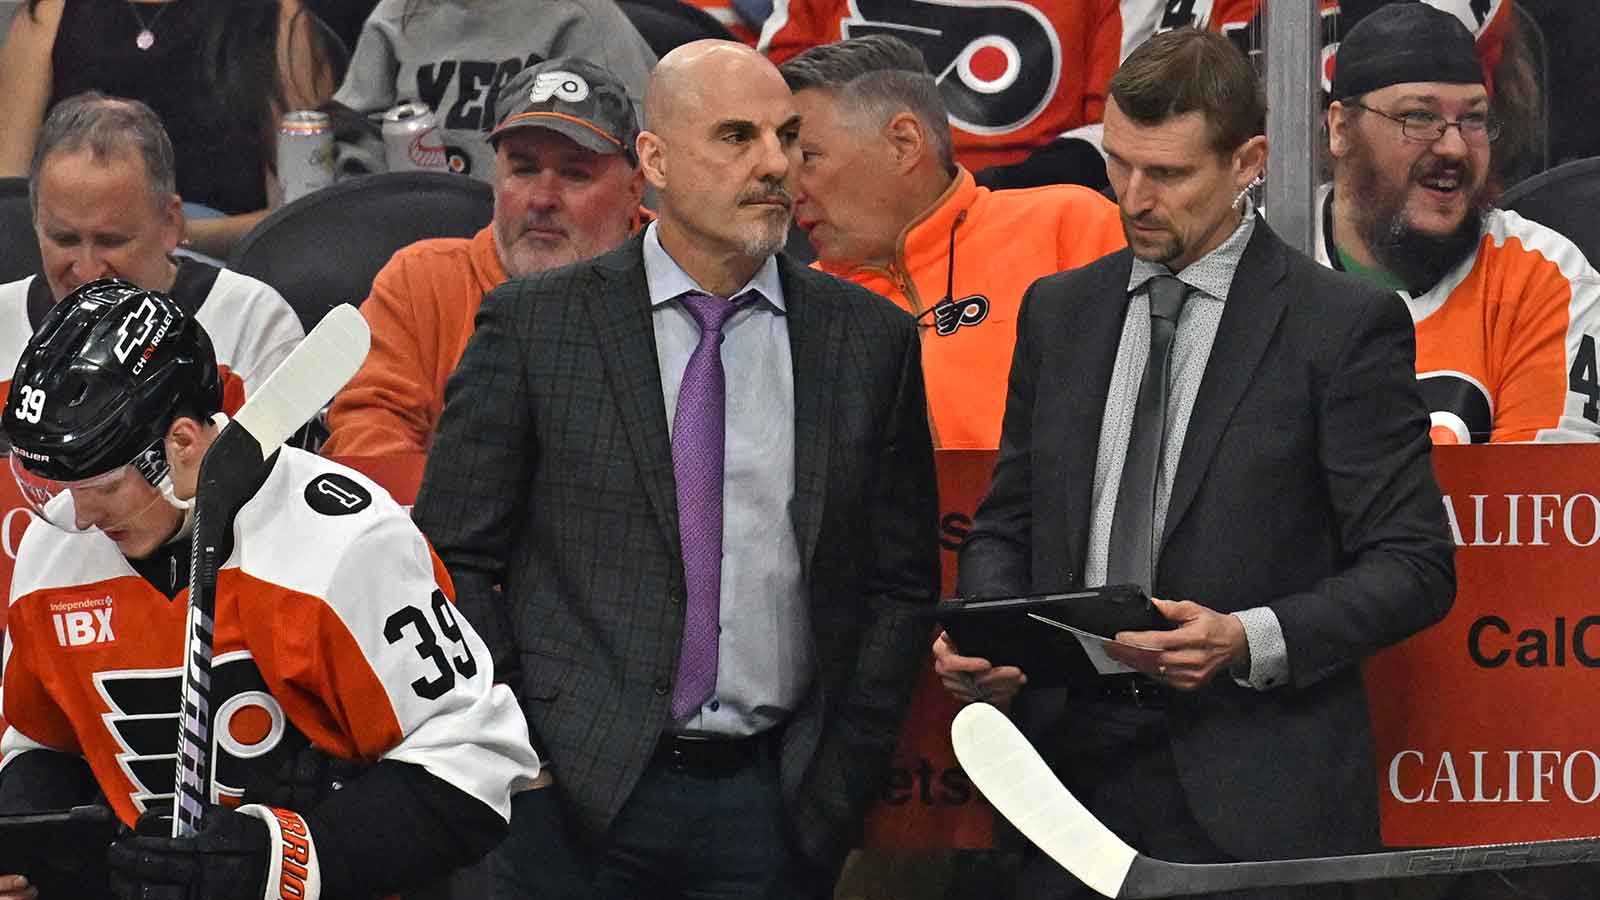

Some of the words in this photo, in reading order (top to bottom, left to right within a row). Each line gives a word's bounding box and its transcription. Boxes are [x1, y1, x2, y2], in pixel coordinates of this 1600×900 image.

[132, 311, 174, 375] CHEVROLET
[15, 385, 46, 424] 39
[53, 607, 115, 647] IBX
[383, 588, 477, 700] 39
[1388, 750, 1600, 803] CALIFO
